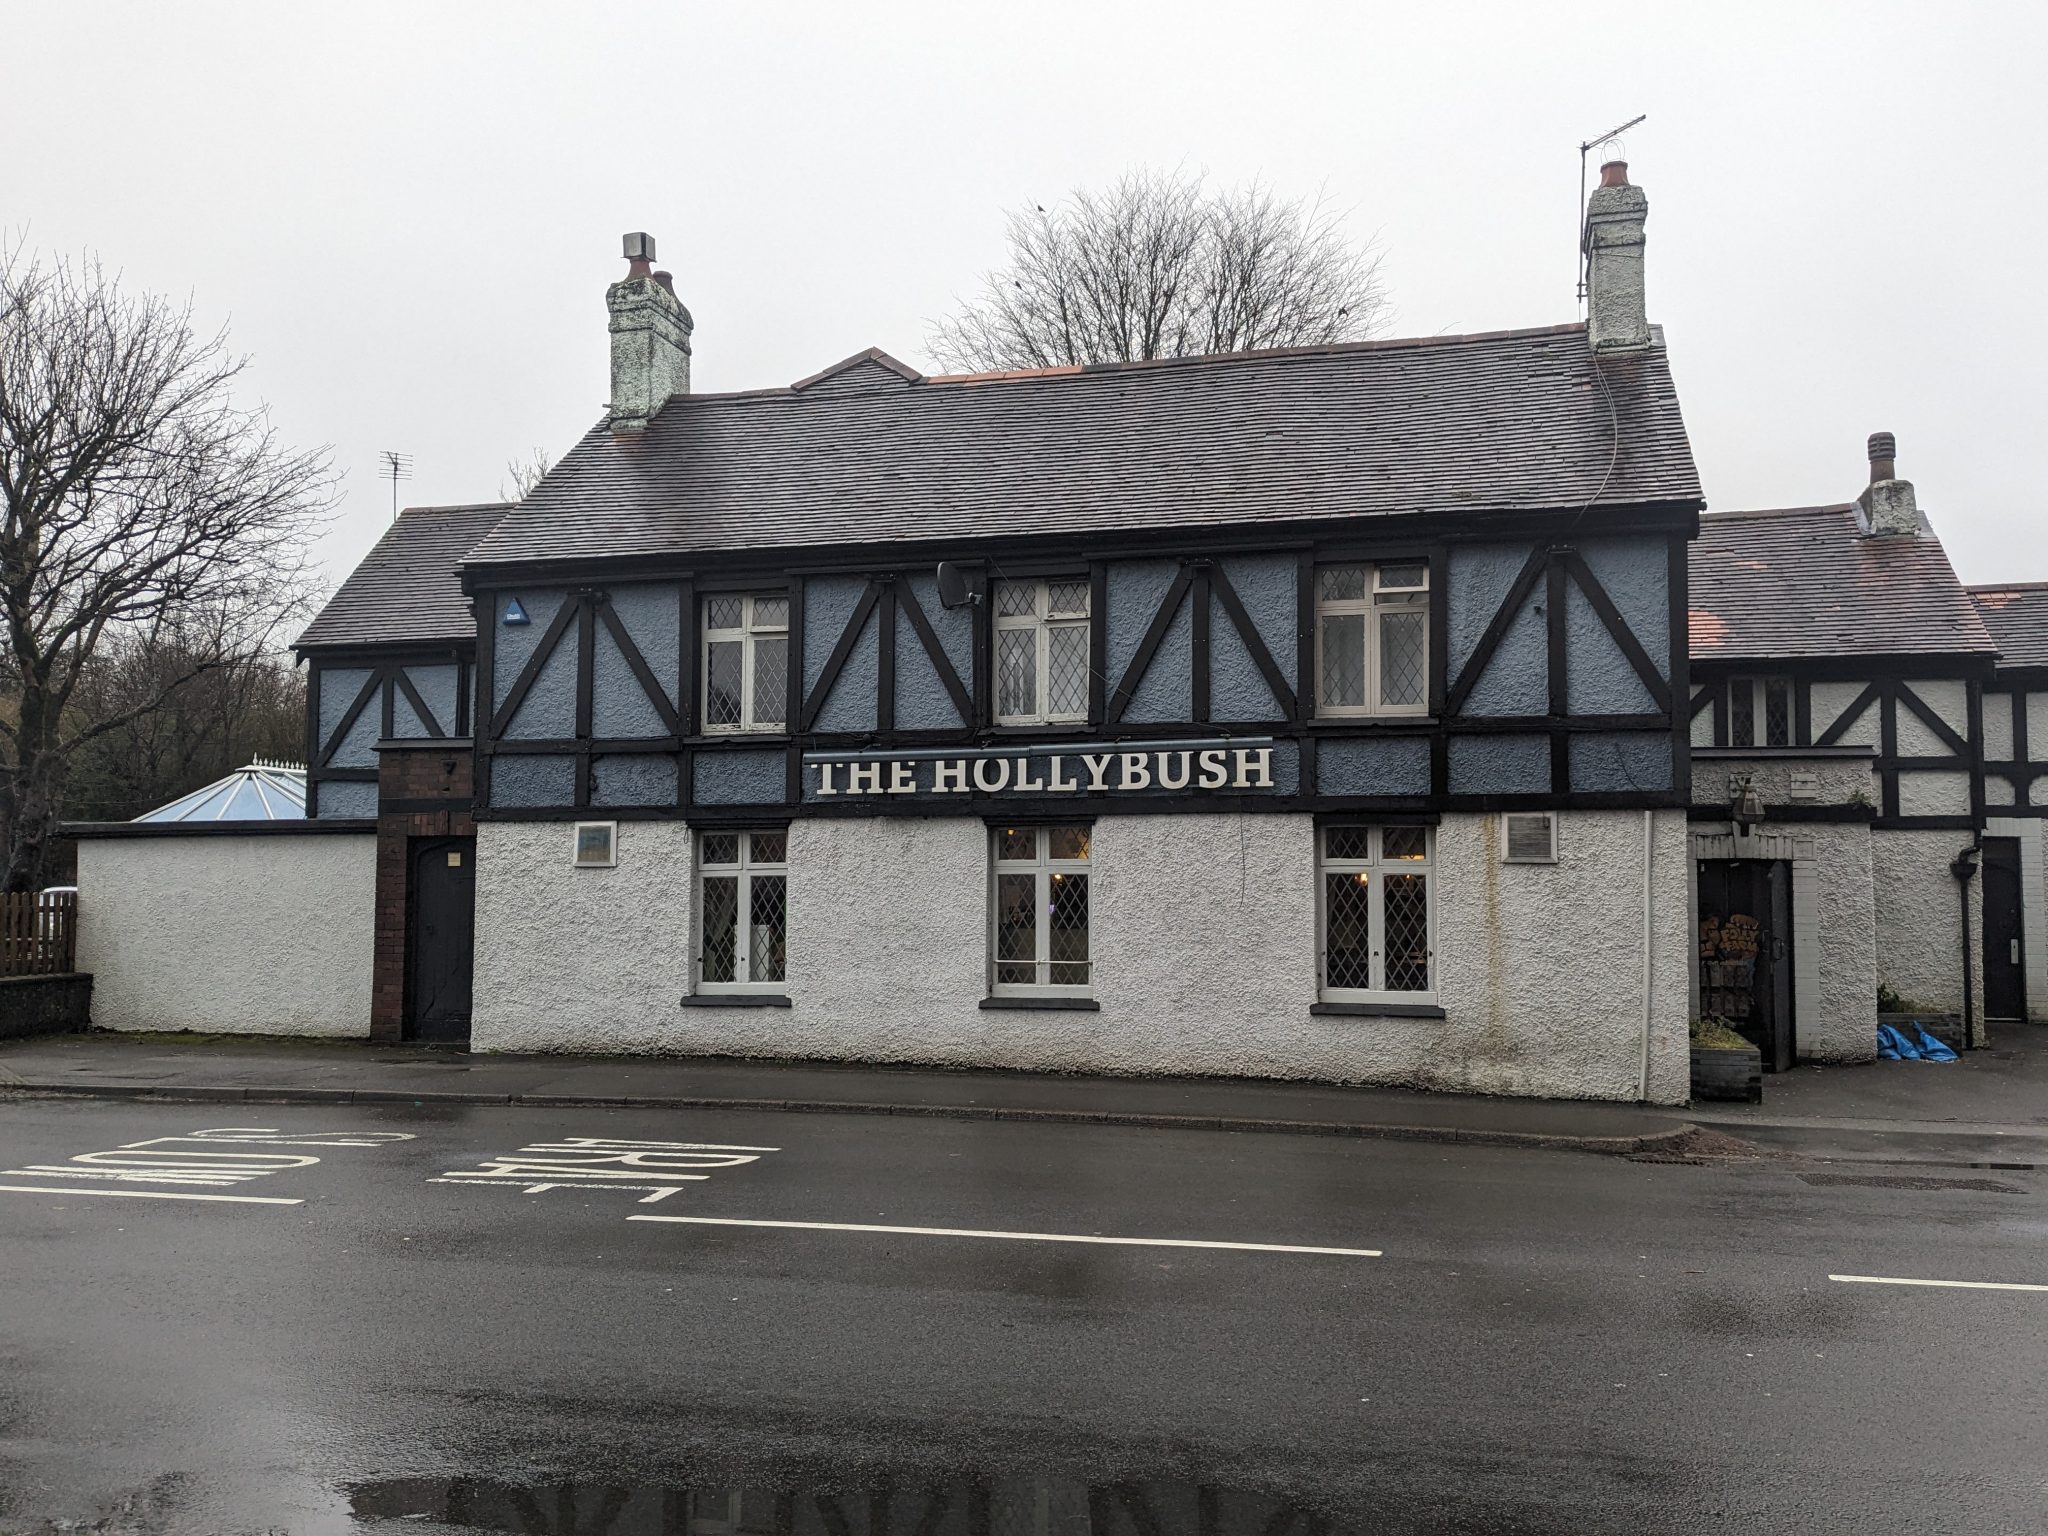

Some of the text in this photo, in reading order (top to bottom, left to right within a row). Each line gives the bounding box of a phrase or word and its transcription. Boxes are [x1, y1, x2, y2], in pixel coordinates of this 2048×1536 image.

[811, 748, 1275, 794] THE HOLLYBUSH
[0, 1128, 417, 1185] SLOW
[425, 1138, 782, 1203] ARAF
